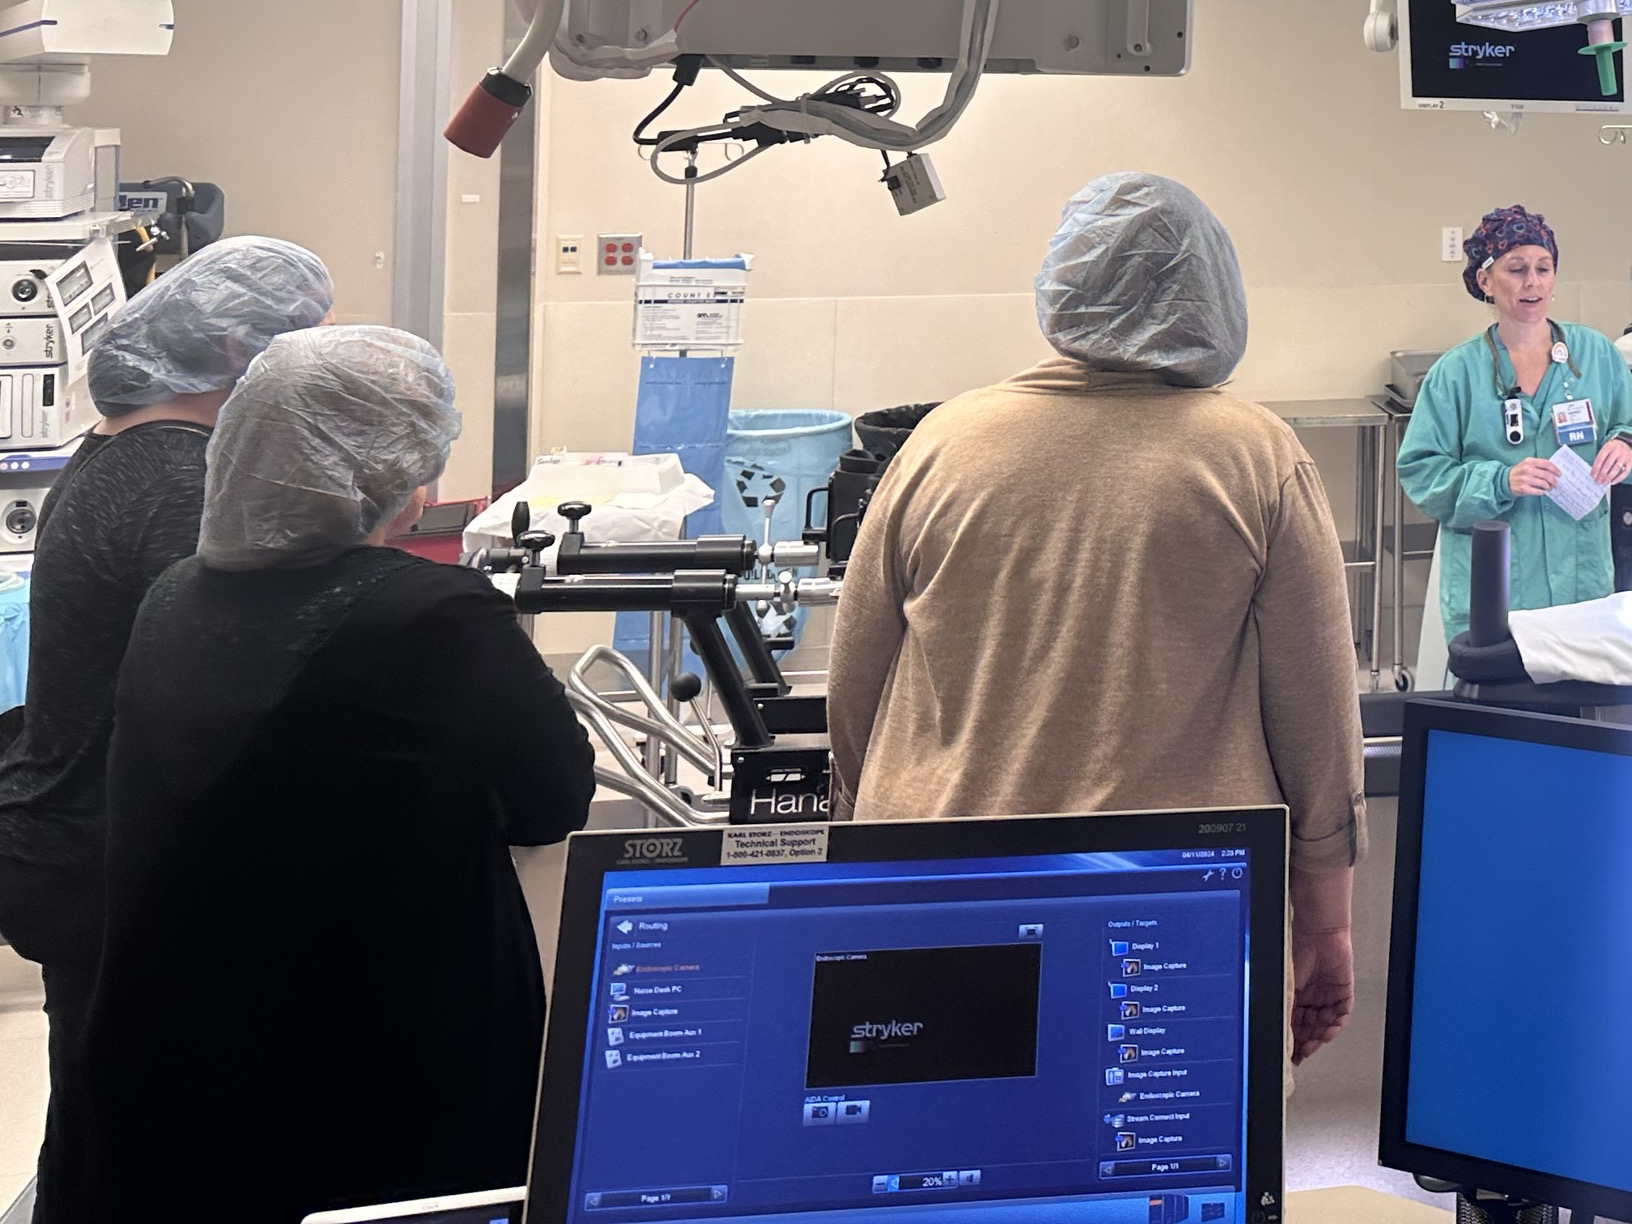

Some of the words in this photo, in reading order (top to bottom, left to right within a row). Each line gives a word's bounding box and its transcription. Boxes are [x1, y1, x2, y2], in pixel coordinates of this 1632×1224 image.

[1449, 41, 1516, 59] stryker
[1439, 101, 1444, 109] 2
[44, 323, 55, 359] stryker
[1568, 431, 1585, 442] RN
[623, 838, 683, 858] STORZ
[735, 839, 778, 848] Technical
[780, 838, 816, 848] Support
[789, 848, 816, 858] Option
[638, 921, 668, 931] Routing
[1107, 920, 1131, 928] Outputs
[1135, 919, 1158, 927] Targets
[1131, 942, 1154, 951] Display
[1143, 963, 1163, 972] Image
[1163, 962, 1187, 970] Capture
[634, 986, 653, 994] Nurse
[654, 985, 671, 993] Desk
[671, 985, 682, 993] PC
[1130, 985, 1153, 993] Display
[631, 1008, 652, 1017] Image
[653, 1007, 678, 1016] Capture
[1142, 1005, 1162, 1014] Image
[1162, 1004, 1186, 1013] Capture
[629, 1030, 664, 1040] Equipment
[664, 1029, 684, 1038] Boom
[684, 1029, 697, 1037] Aux
[851, 1019, 924, 1041] stryker
[1129, 1027, 1143, 1035] Wall
[1143, 1027, 1166, 1035] Display
[627, 1052, 662, 1062] Equipment
[662, 1051, 682, 1060] Boom
[682, 1051, 694, 1059] Aux
[1141, 1048, 1160, 1057] Image
[1160, 1047, 1185, 1056] Capture
[1127, 1071, 1147, 1079] Image
[1148, 1070, 1171, 1078] Capture
[822, 1094, 846, 1102] Control
[1139, 1092, 1175, 1100] Endoscopic
[1175, 1090, 1200, 1098] Camera
[1126, 1115, 1149, 1123] Stream
[1138, 1136, 1158, 1145] Image
[1158, 1135, 1183, 1143] Capture
[1151, 1163, 1169, 1172] Page
[922, 1176, 943, 1187] 20%
[641, 1194, 660, 1203] Page
